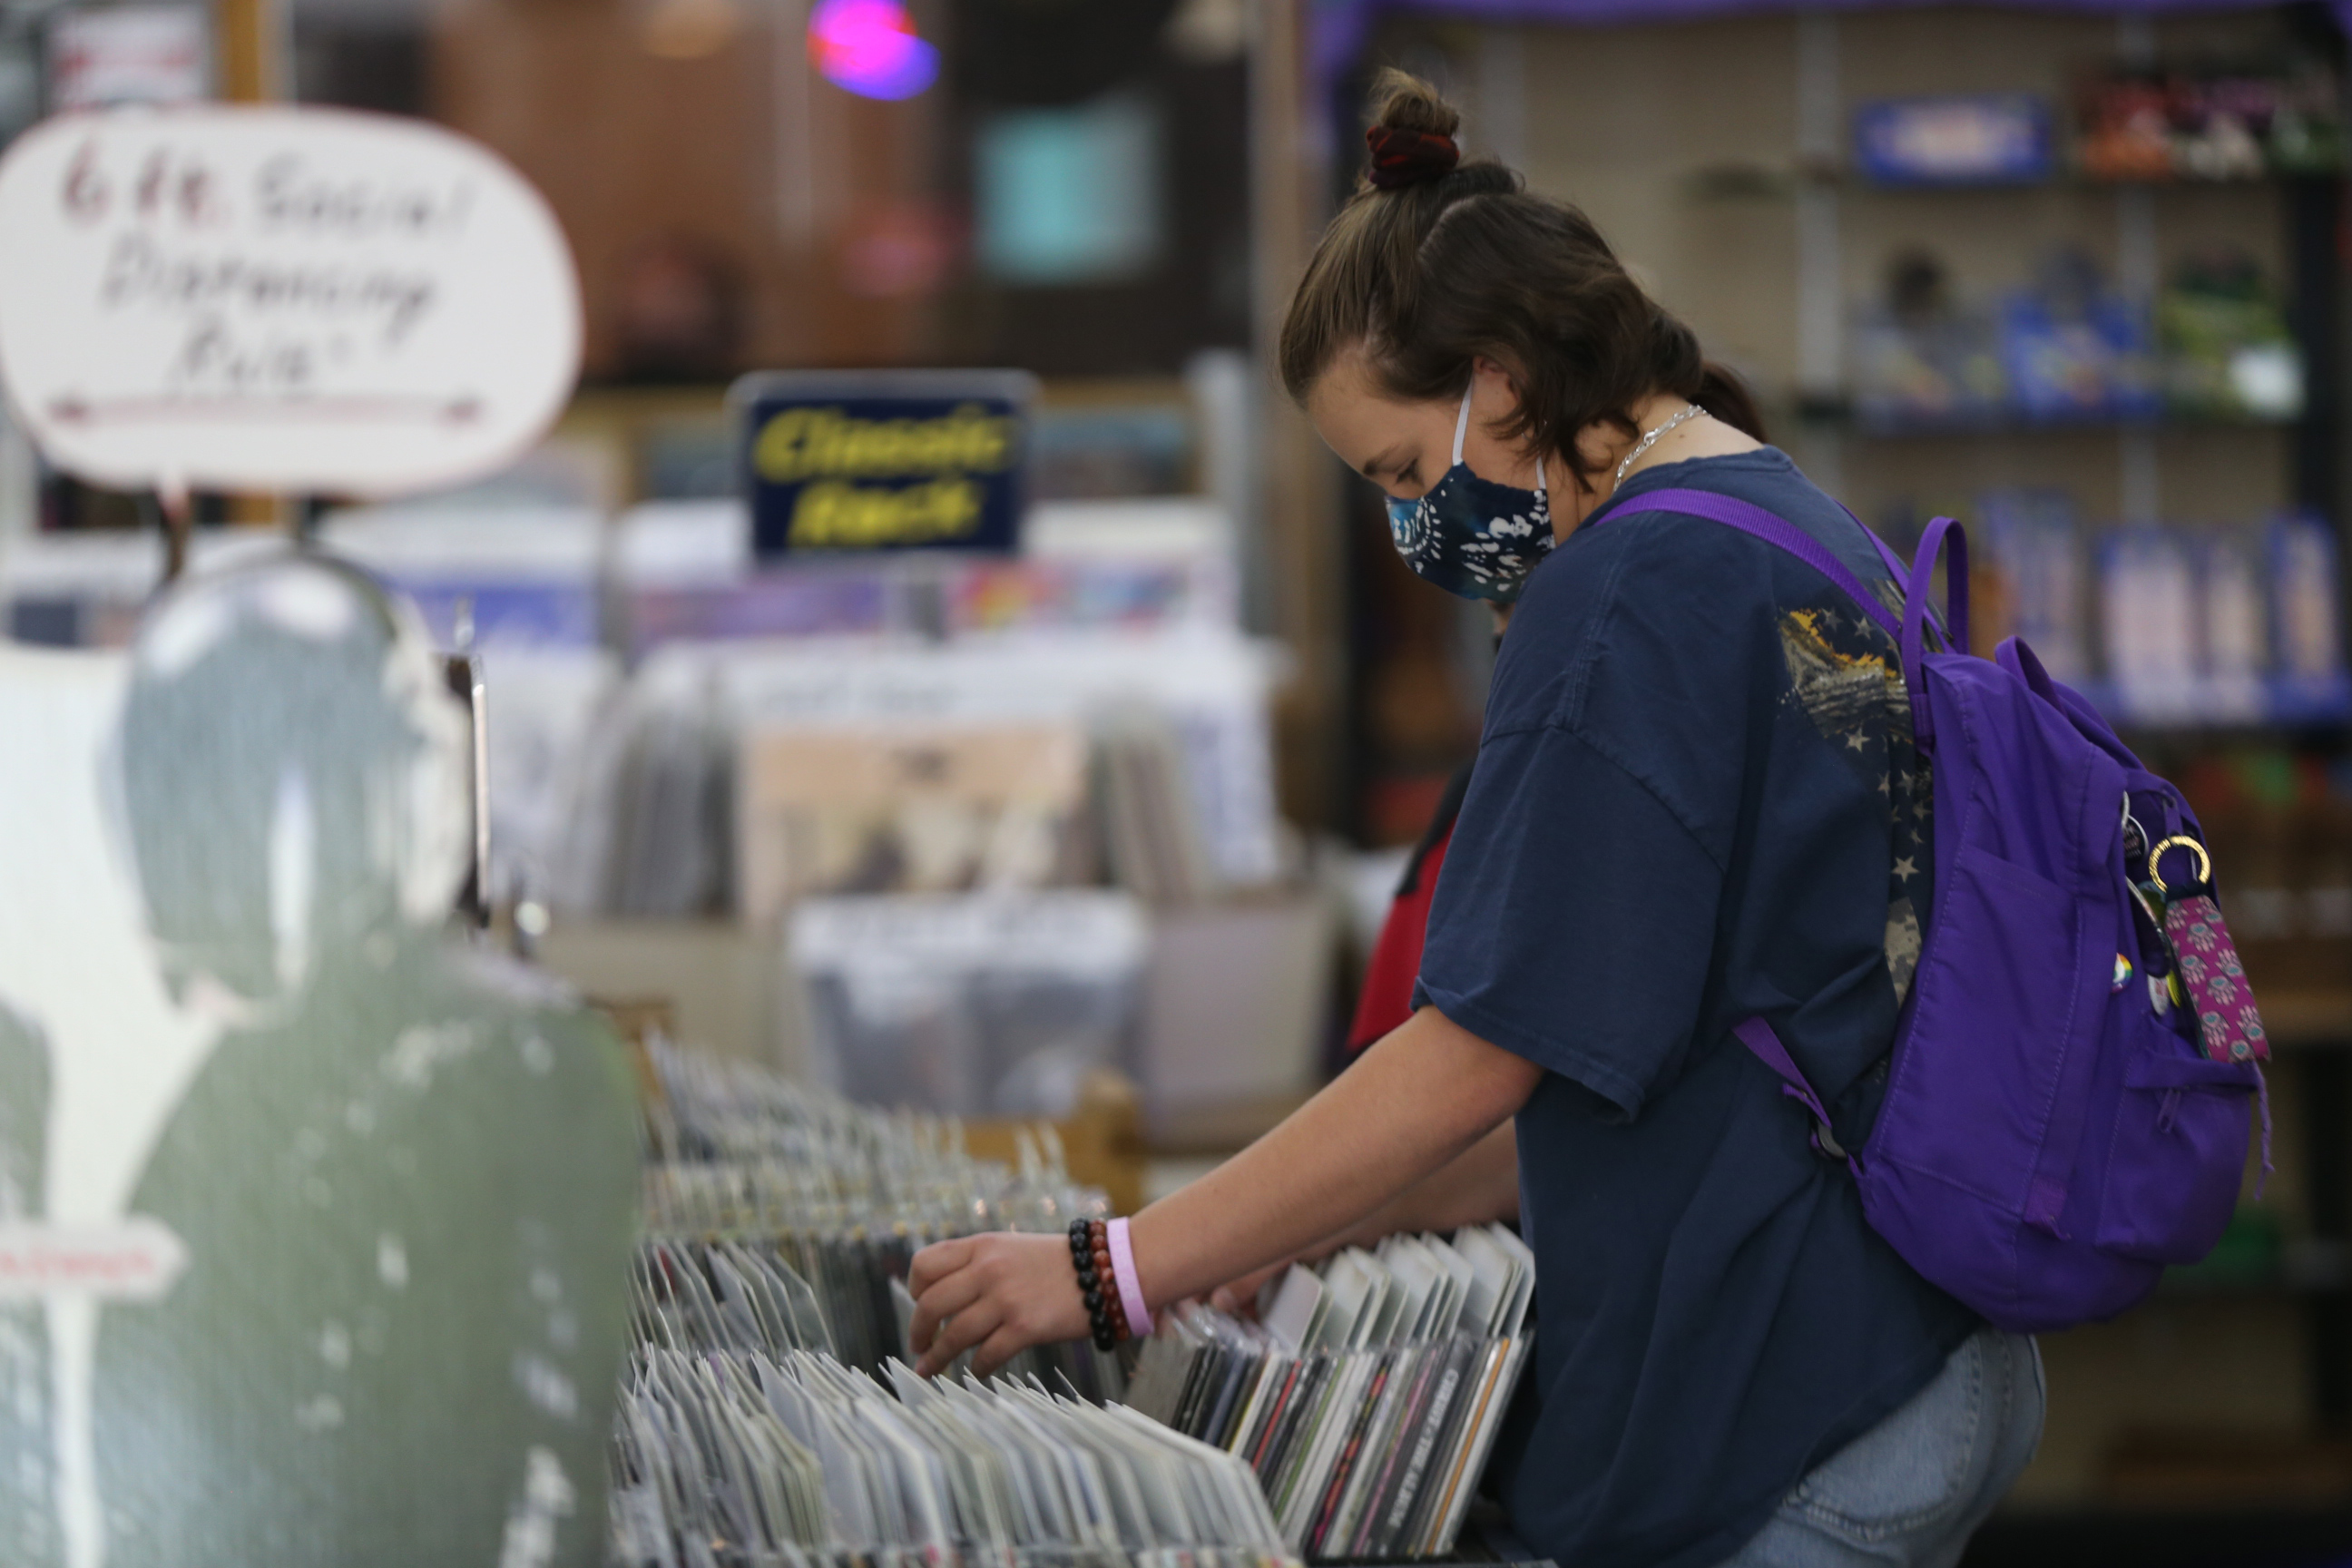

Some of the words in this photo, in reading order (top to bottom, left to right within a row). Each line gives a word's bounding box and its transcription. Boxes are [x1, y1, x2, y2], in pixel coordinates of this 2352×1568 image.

[59, 136, 110, 227] 6
[250, 150, 481, 240] Social
[99, 230, 439, 358] Distancing
[755, 406, 1016, 483] Classic
[787, 477, 984, 548] Rock
[1409, 1436, 1435, 1473] THE
[1387, 1469, 1420, 1528] ALBUM
